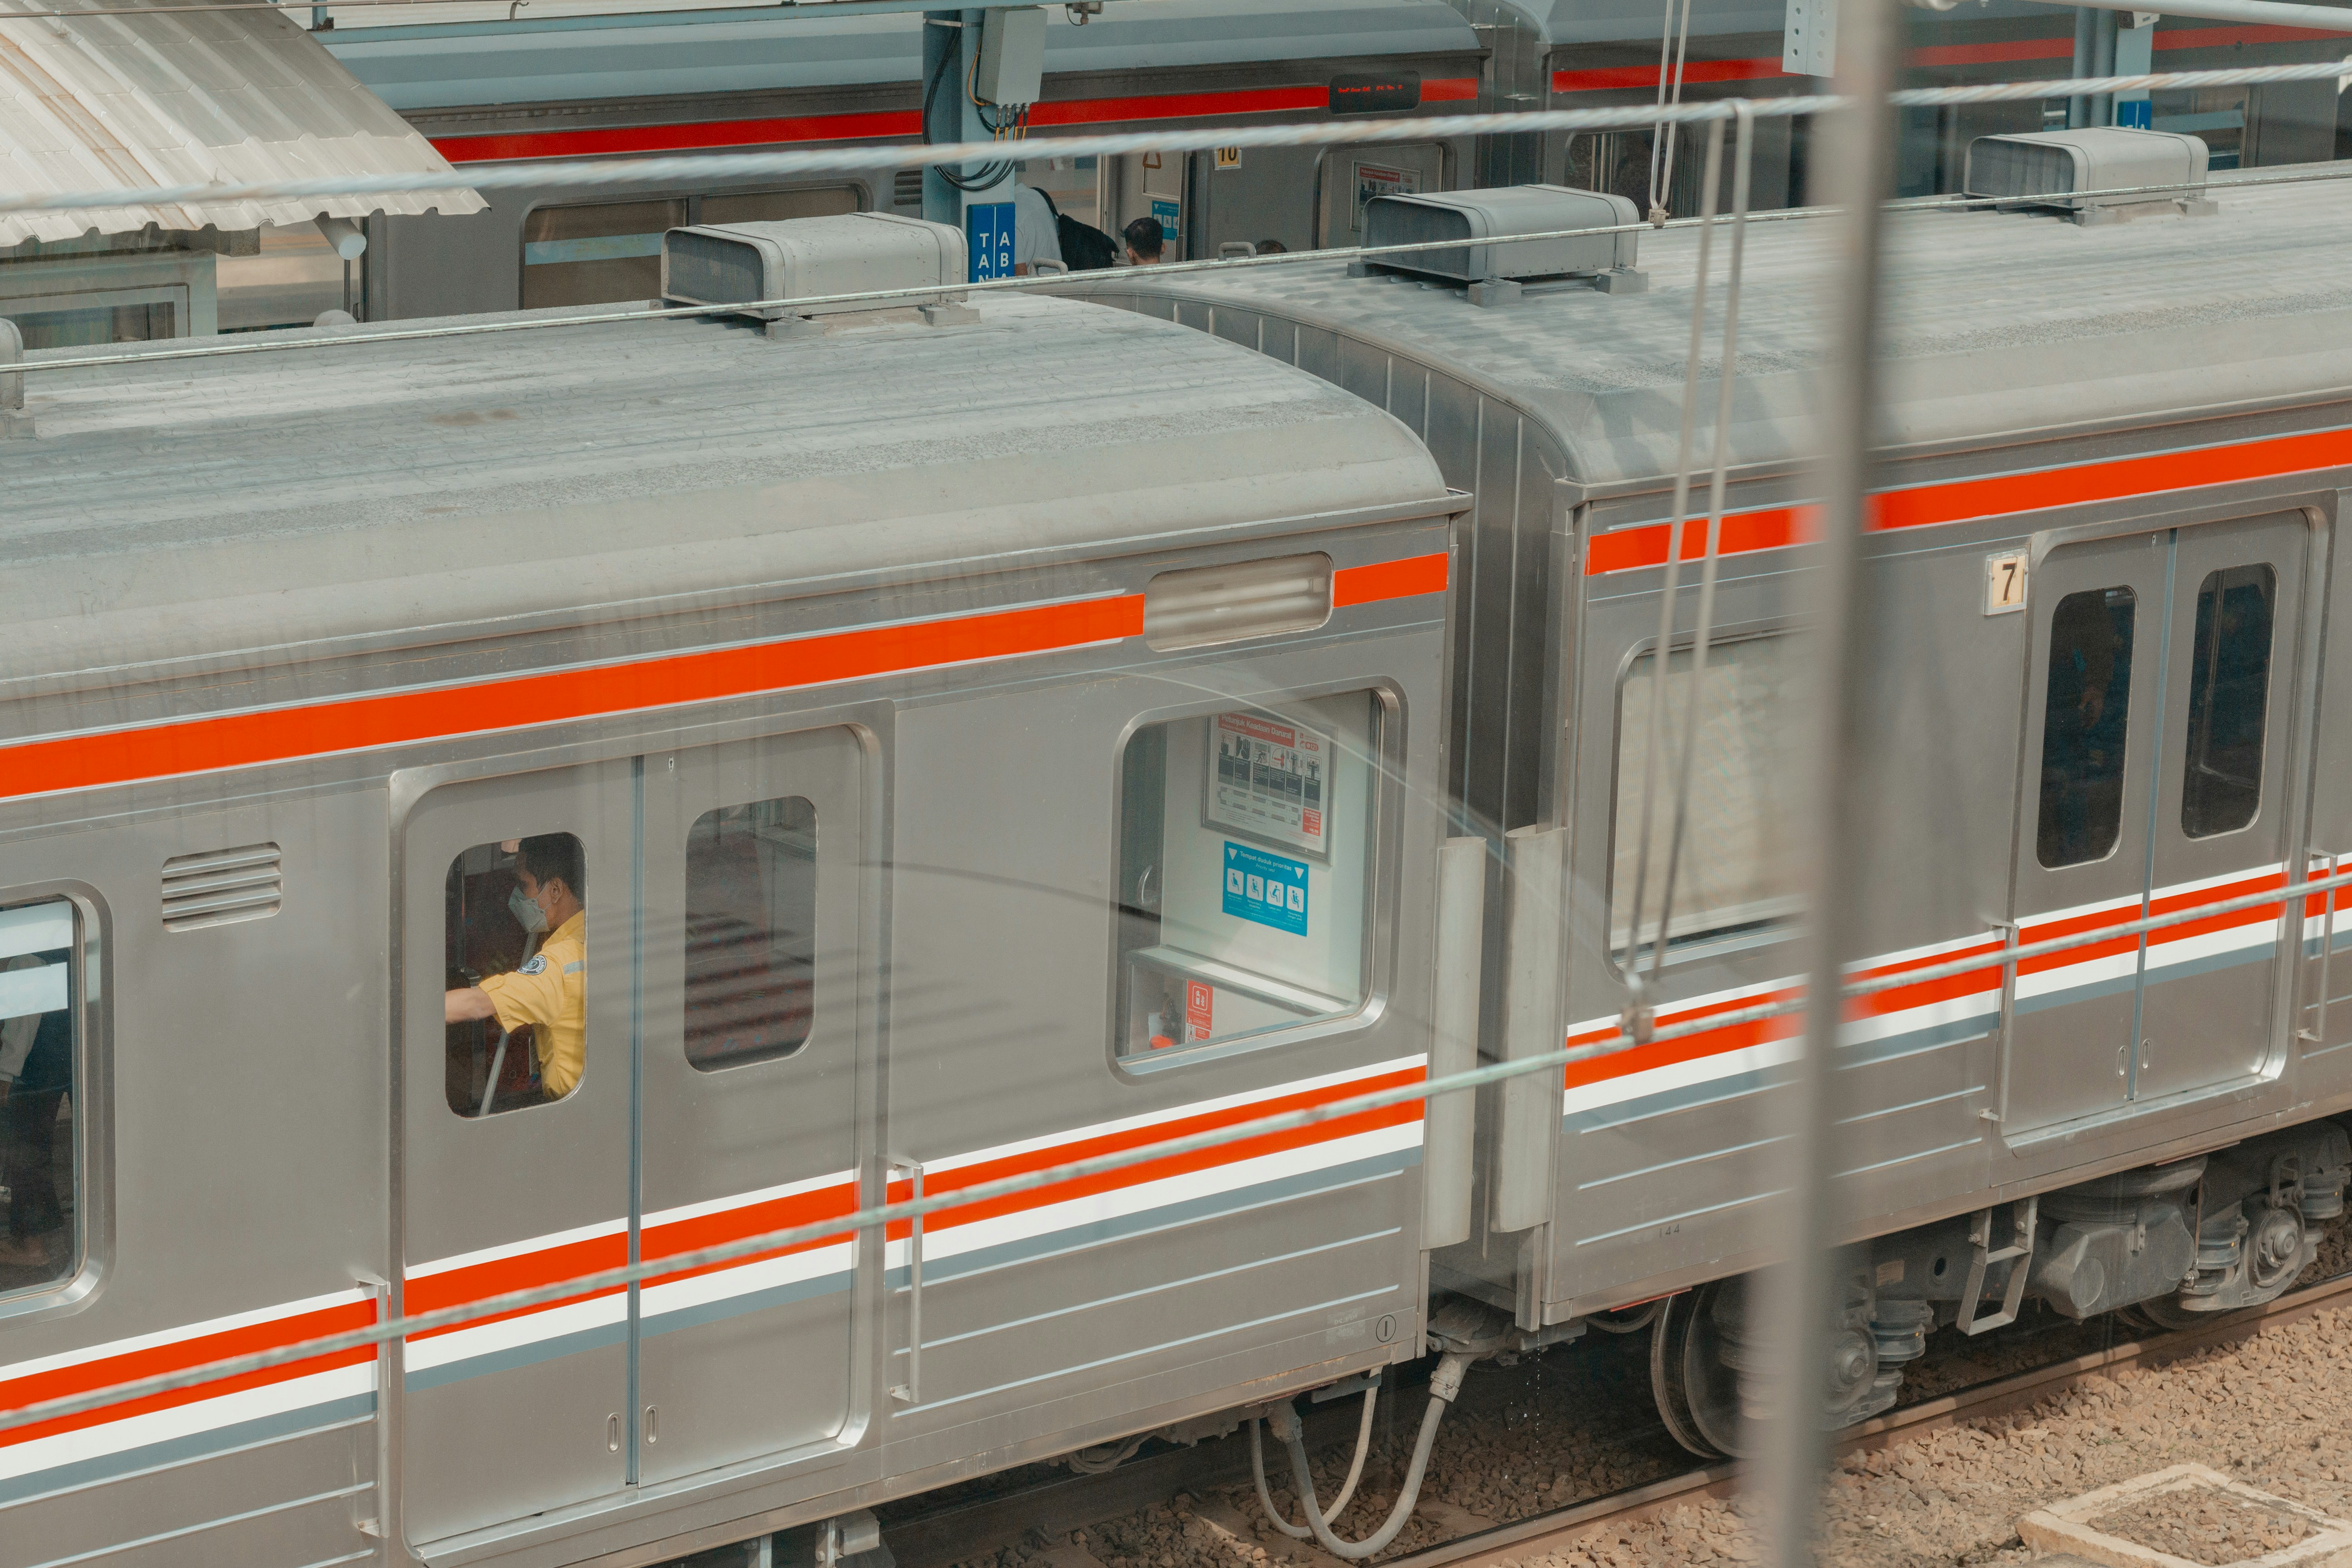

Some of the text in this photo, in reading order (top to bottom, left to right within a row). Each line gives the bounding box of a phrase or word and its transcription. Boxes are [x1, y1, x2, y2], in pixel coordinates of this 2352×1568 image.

[1218, 147, 1237, 162] 10
[2002, 563, 2016, 601] 7
[1221, 715, 1245, 727] Petunjuk
[1246, 721, 1270, 734] Keadaan
[1271, 727, 1292, 740] Darurat
[1240, 851, 1292, 871] Tempat duduk prioritas
[1659, 1224, 1680, 1238] 144
